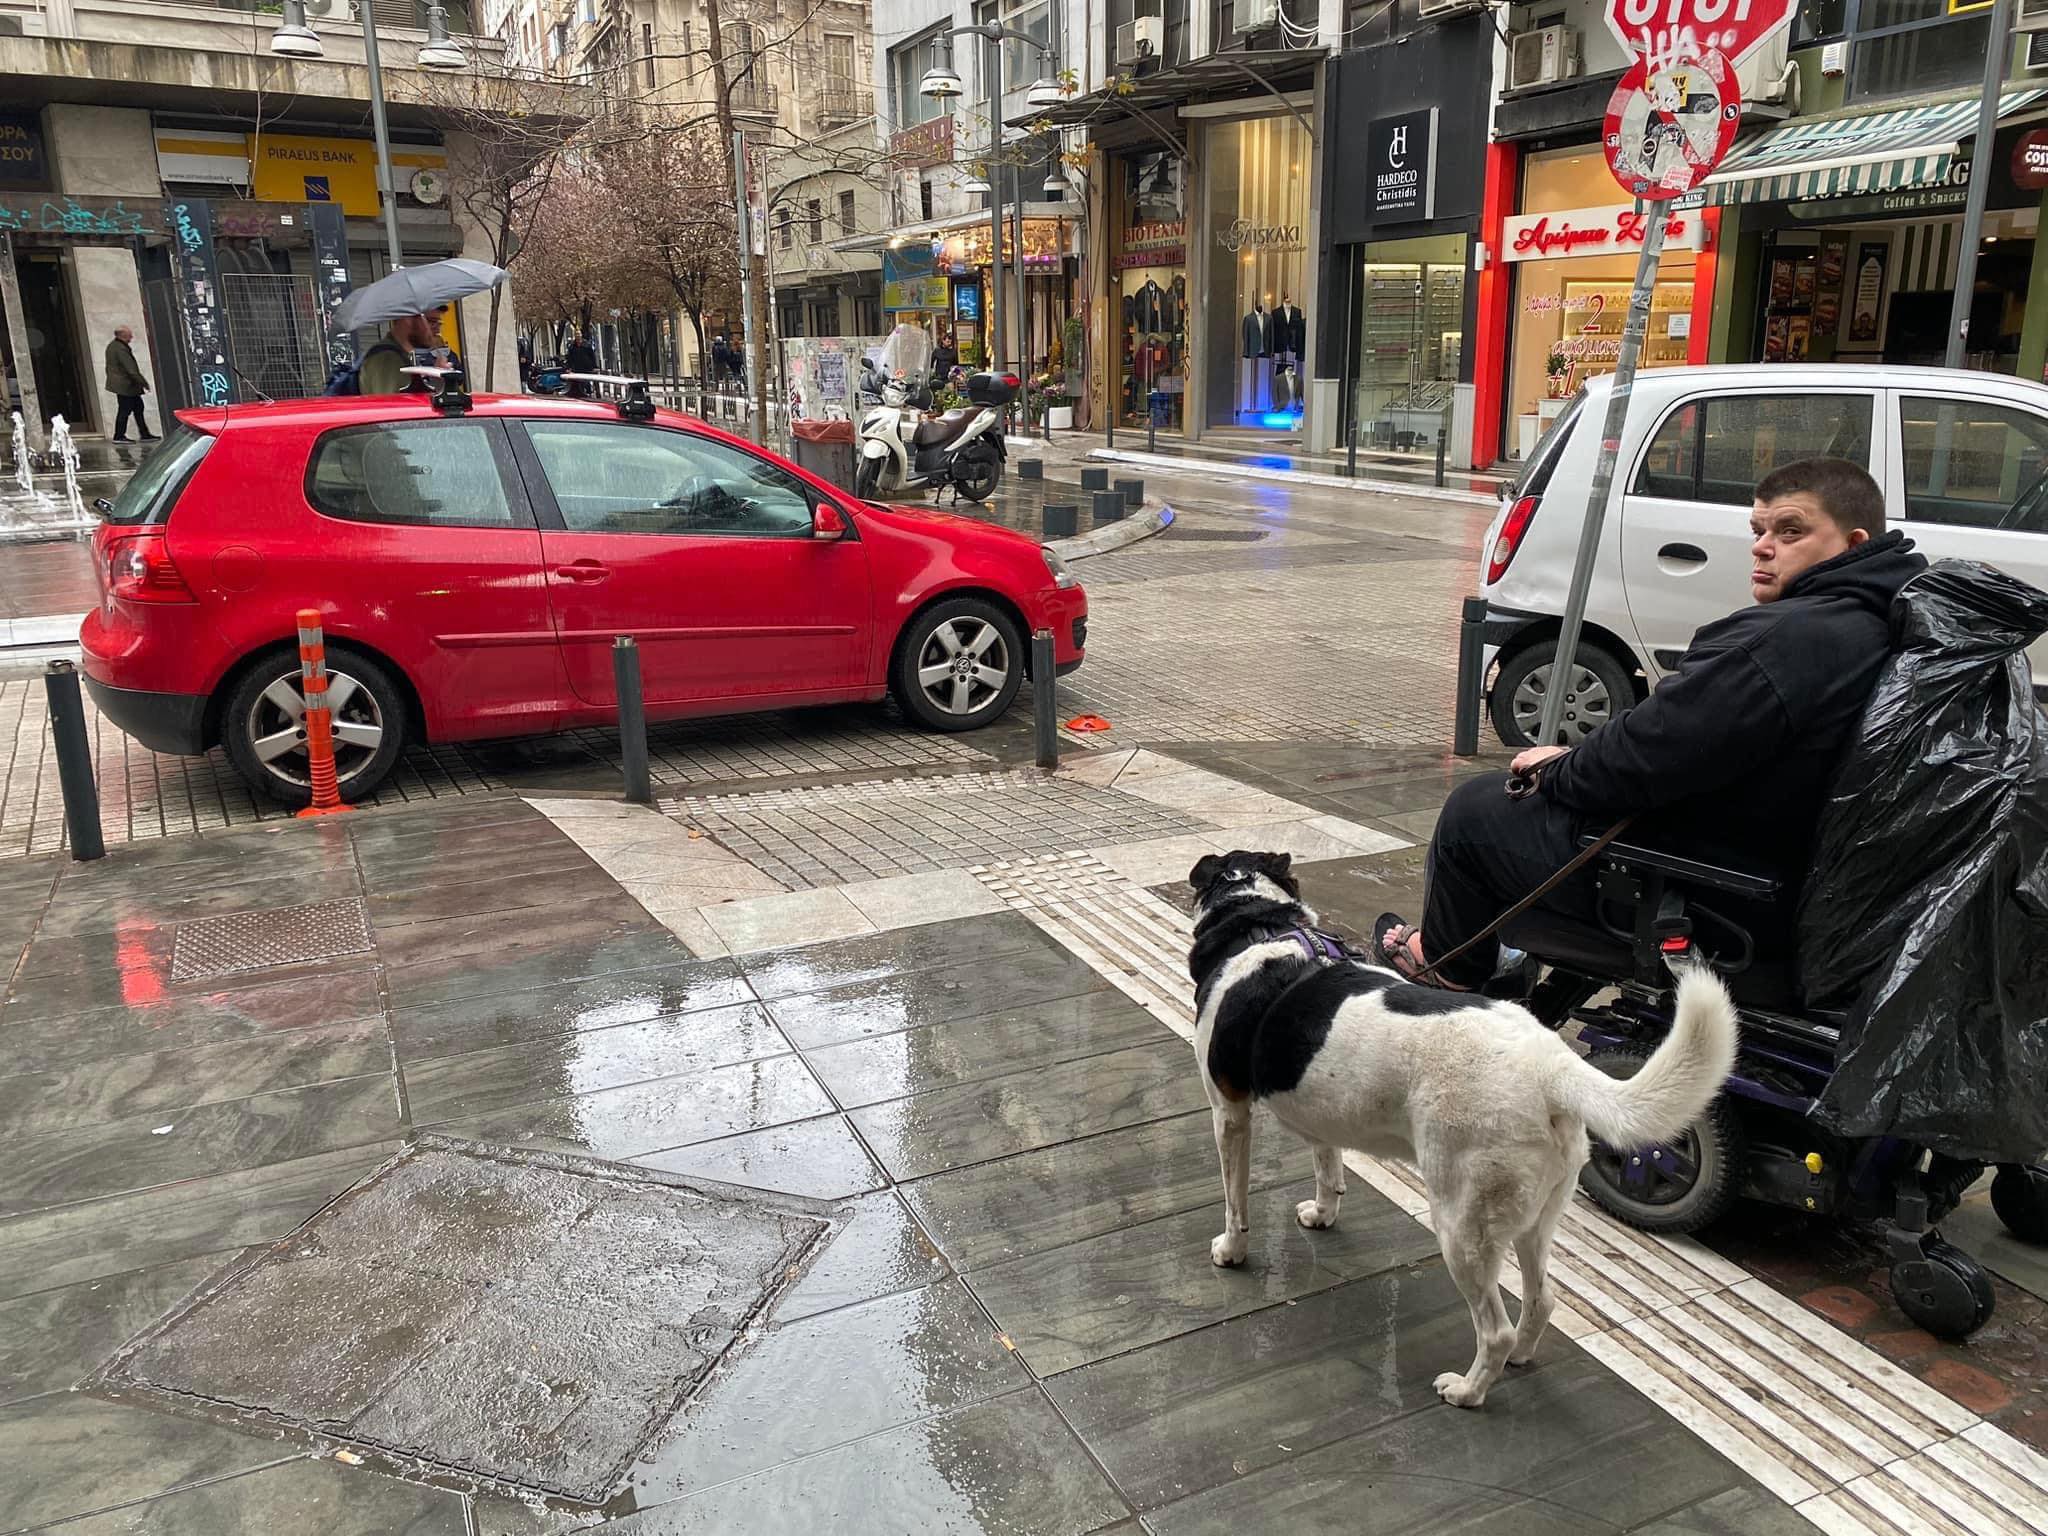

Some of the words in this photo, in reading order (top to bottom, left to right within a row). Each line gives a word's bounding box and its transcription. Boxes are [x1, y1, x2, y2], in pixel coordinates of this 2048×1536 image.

[268, 148, 319, 161] PIRAEUS
[323, 150, 356, 164] BANK
[1377, 169, 1417, 187] HARDECO
[1377, 187, 1417, 201] Christidis
[1883, 196, 1915, 209] Coffee
[1919, 194, 1926, 205] &
[1930, 191, 1967, 205] Snacks
[1580, 294, 1605, 332] 2
